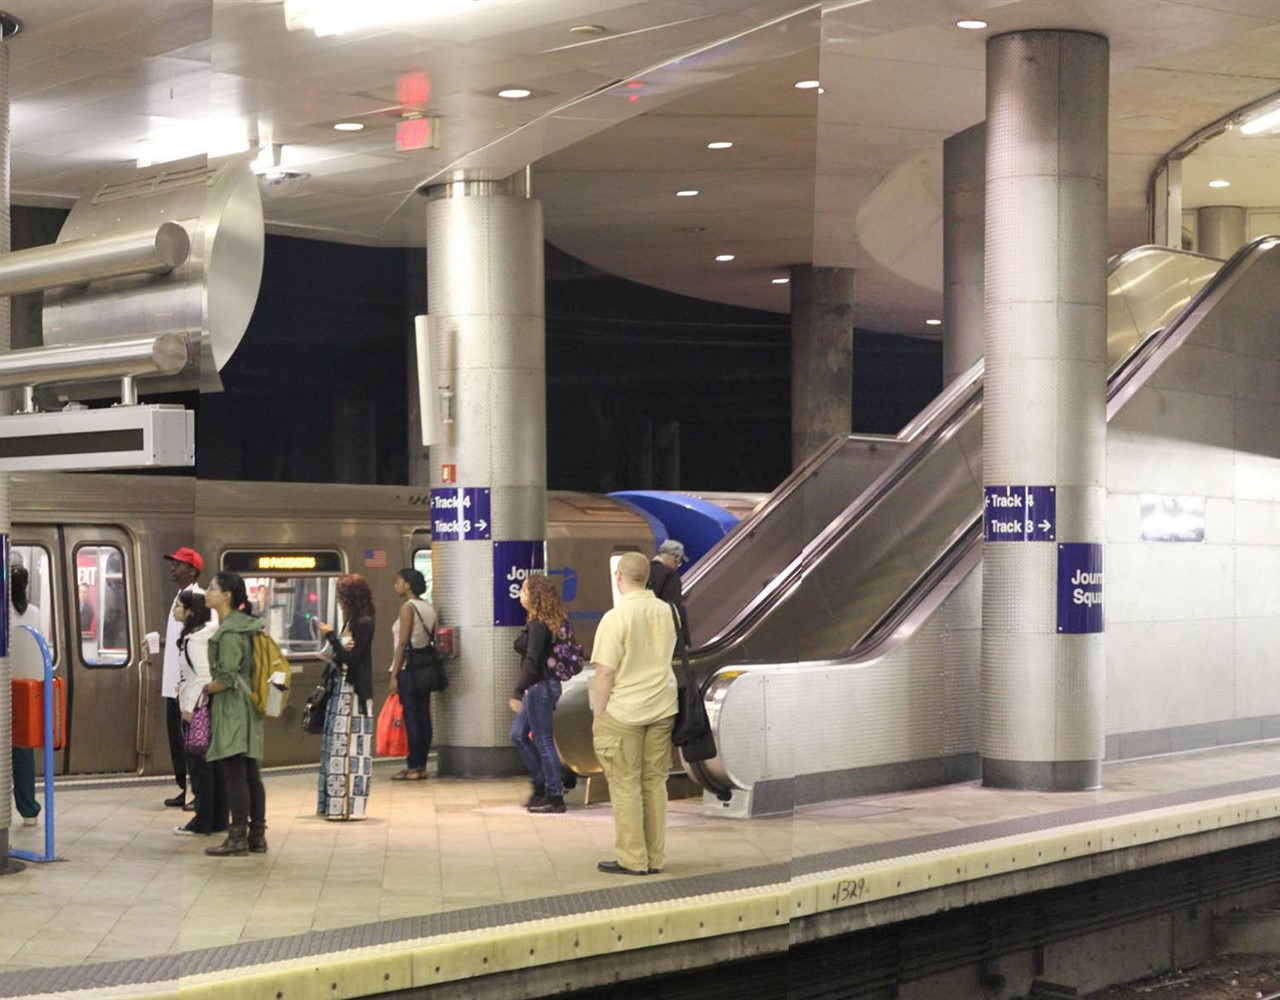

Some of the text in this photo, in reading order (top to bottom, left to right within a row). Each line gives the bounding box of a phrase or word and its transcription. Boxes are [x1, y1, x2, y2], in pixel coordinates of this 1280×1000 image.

[434, 496, 460, 508] Track
[462, 496, 471, 508] 4
[992, 494, 1034, 507] Track 4
[434, 520, 471, 532] Track 3
[991, 520, 1034, 533] Track 3
[1071, 569, 1103, 585] Jour
[1073, 588, 1103, 608] Squa
